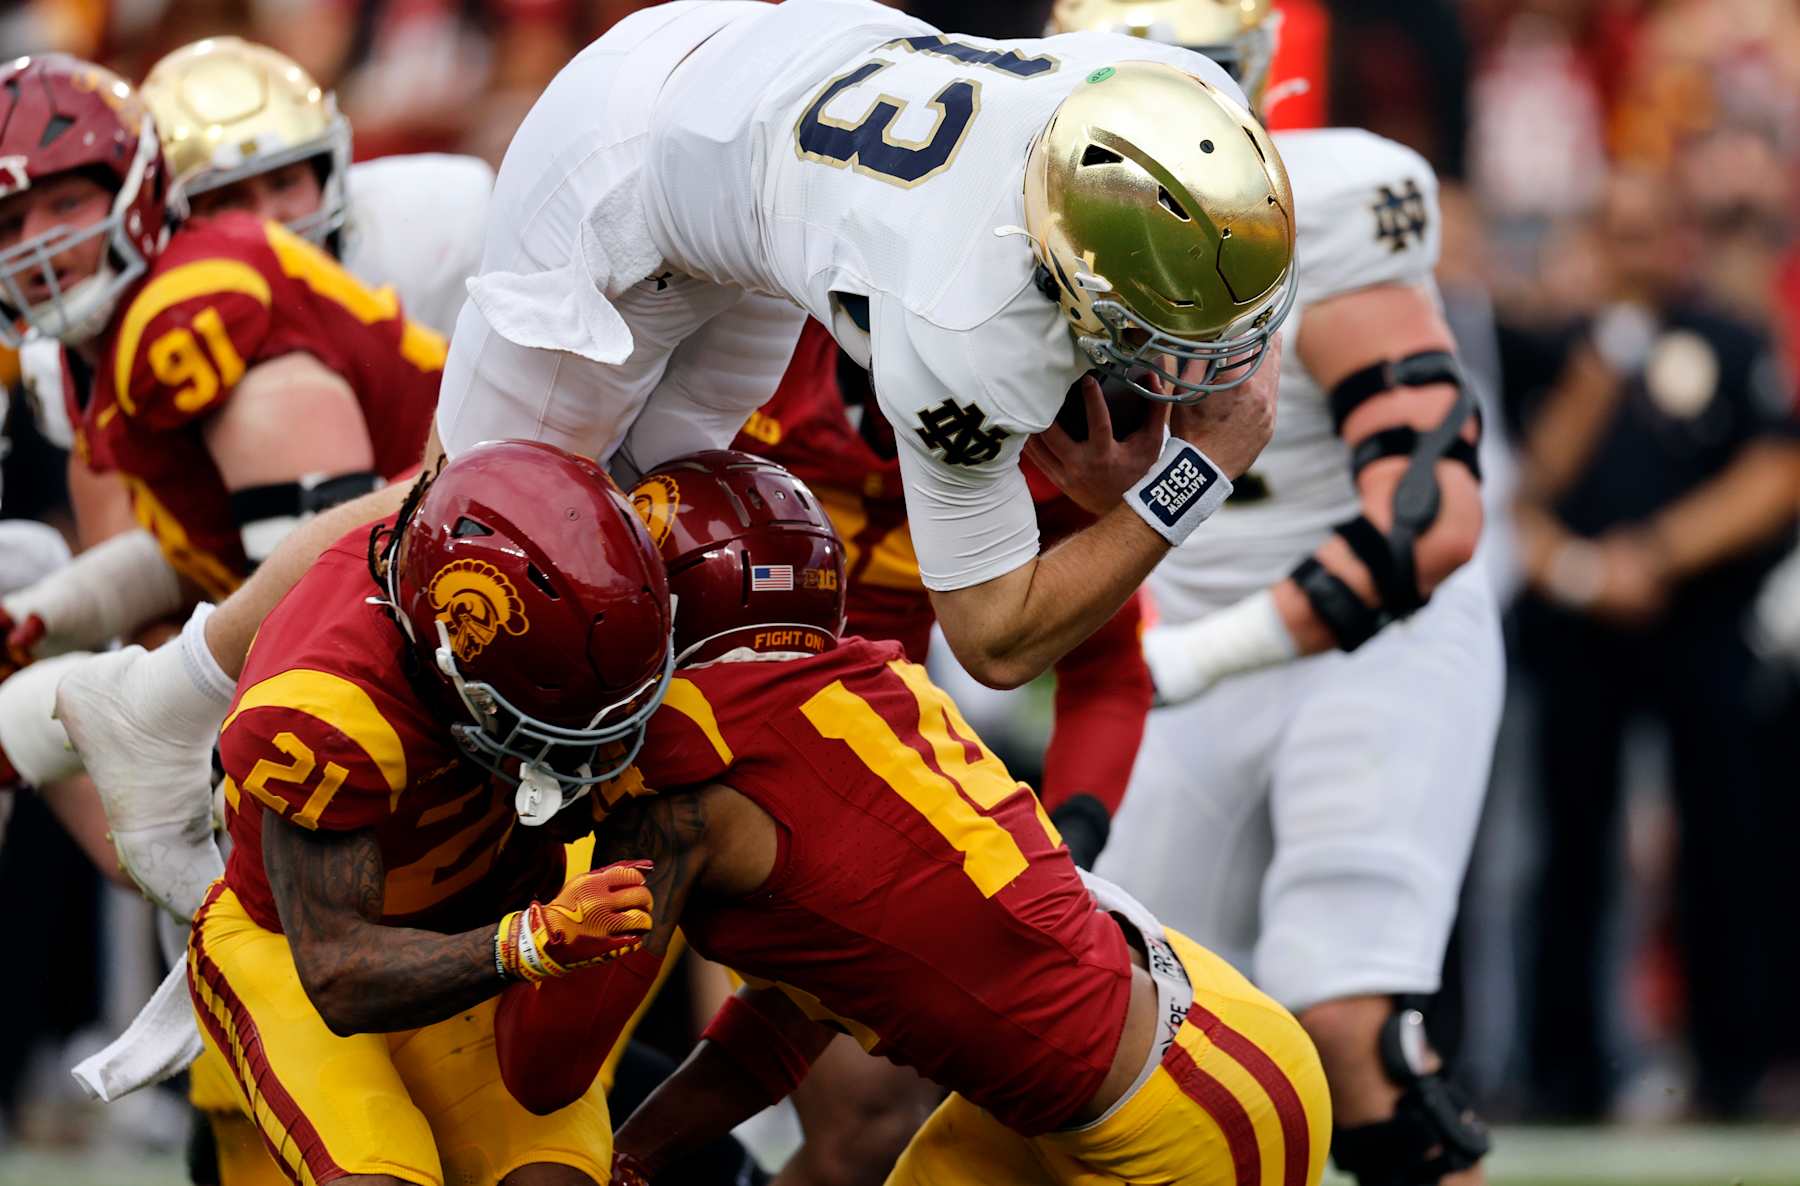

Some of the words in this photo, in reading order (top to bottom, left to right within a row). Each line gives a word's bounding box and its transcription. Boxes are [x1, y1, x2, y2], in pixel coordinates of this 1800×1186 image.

[148, 306, 246, 412] 91
[1149, 457, 1199, 507] 23:12
[1166, 472, 1208, 516] MATTHEW
[754, 629, 803, 651] FIGHT
[242, 731, 350, 832] 21
